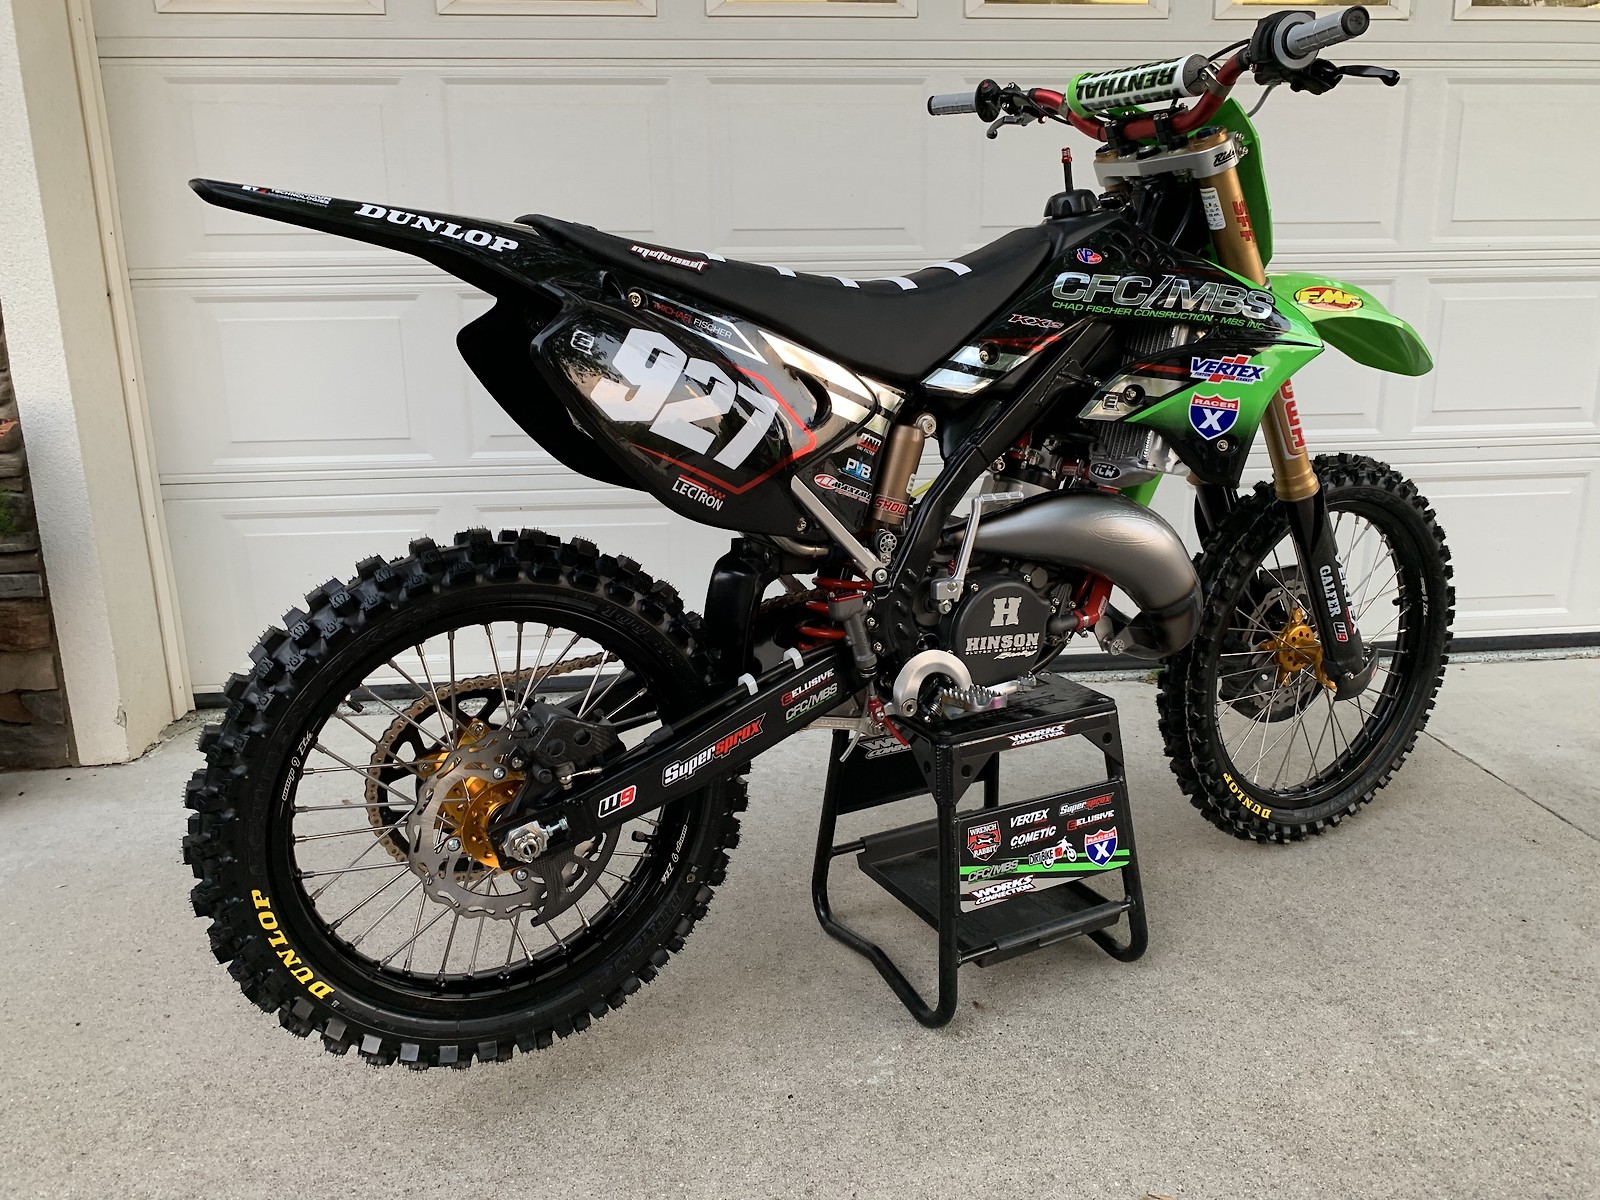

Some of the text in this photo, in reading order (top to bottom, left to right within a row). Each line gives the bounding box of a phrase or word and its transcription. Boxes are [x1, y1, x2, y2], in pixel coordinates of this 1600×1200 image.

[1076, 65, 1179, 100] RENTHAL
[354, 203, 519, 253] DUNLOP
[1052, 272, 1275, 320] CFC/MBS
[1300, 289, 1361, 304] FMF
[653, 302, 733, 339] MICHAEL FISCHER
[1052, 301, 1083, 312] CHAD
[1086, 304, 1132, 316] FISCHER
[1221, 317, 1244, 328] MBS
[1192, 358, 1265, 380] VERTEX
[590, 328, 779, 470] 927
[1194, 398, 1237, 410] RACER
[1199, 408, 1226, 432] X
[672, 477, 724, 512] LECTRON
[1320, 564, 1341, 618] GALFER
[990, 597, 1022, 627] H
[965, 632, 1040, 652] HINSON
[791, 668, 835, 699] ELUSIVE
[785, 683, 838, 721] CFC/MBS
[1008, 724, 1066, 741] WORKS
[663, 716, 764, 786] Supersprox
[1223, 772, 1272, 819] DUNLOP
[1010, 808, 1050, 829] VERTEX
[1076, 810, 1115, 827] ELUSIVE
[1010, 826, 1057, 847] COMETIC
[1087, 832, 1115, 844] RACER
[1094, 843, 1109, 861] X
[968, 859, 1020, 883] CFC/MBS
[972, 874, 1035, 898] WORKS
[975, 883, 1034, 905] CONNECTION
[251, 889, 336, 999] DUNLOP
